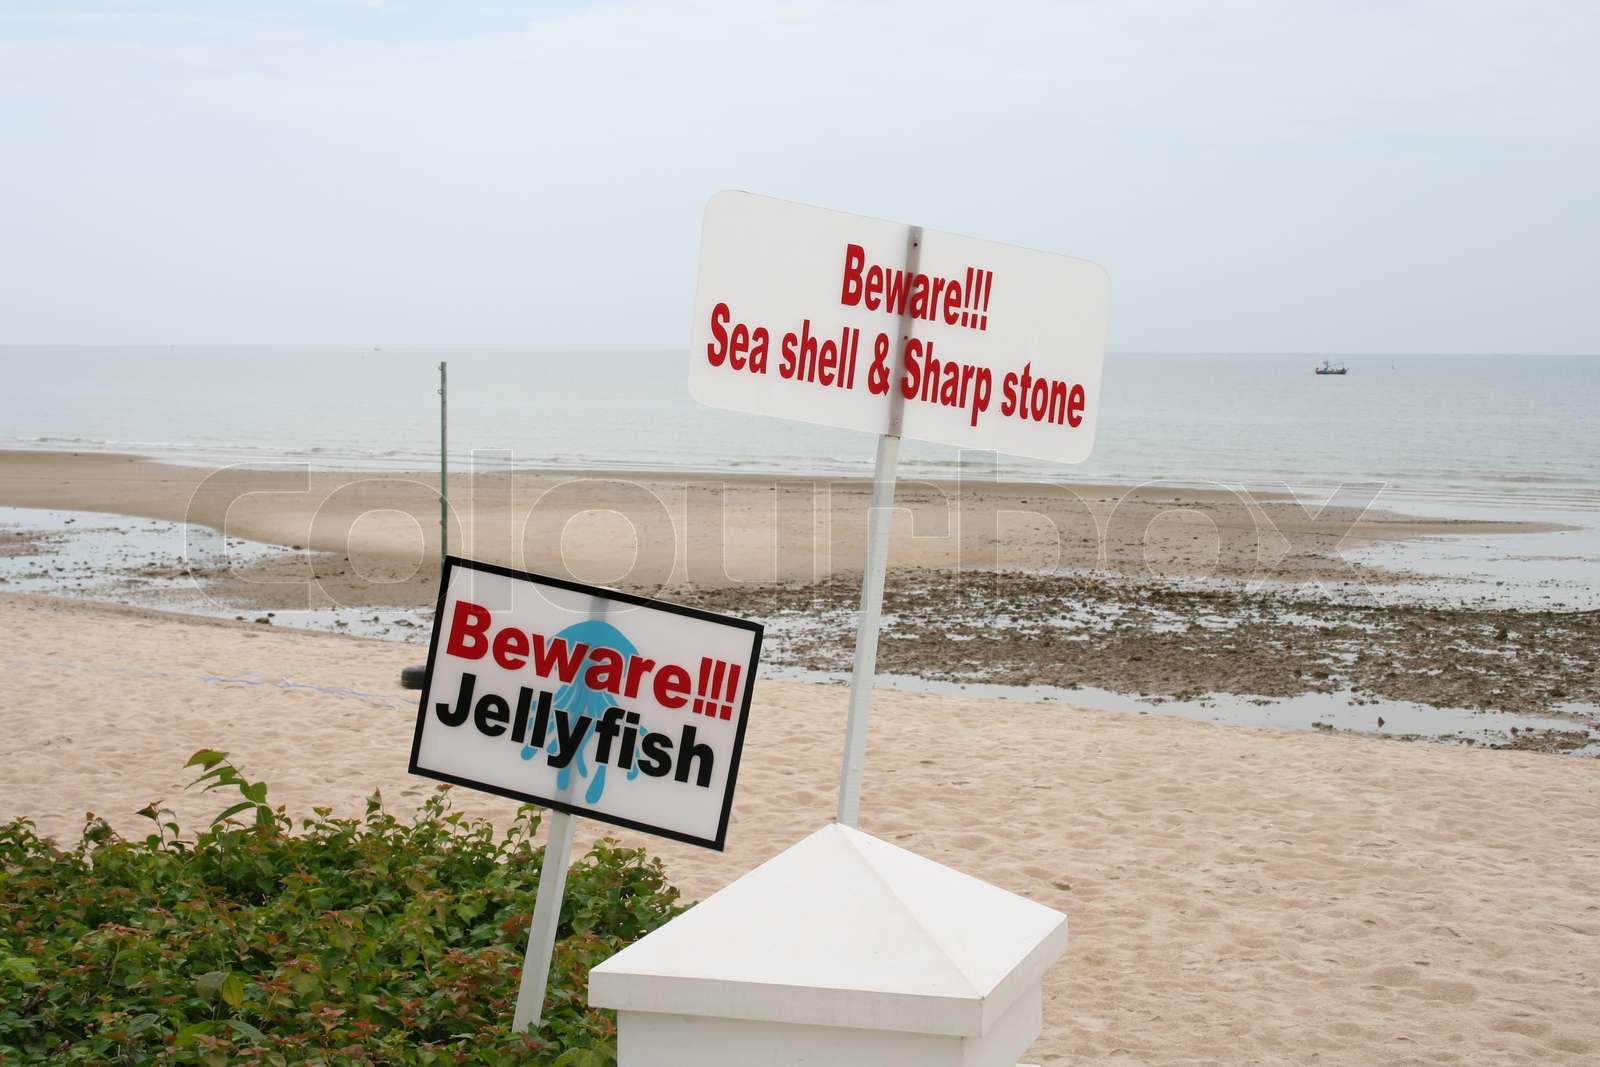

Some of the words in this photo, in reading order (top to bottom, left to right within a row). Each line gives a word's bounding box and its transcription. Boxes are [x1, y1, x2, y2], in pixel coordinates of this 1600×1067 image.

[841, 243, 993, 331] Beware!!!
[706, 303, 769, 374] Sea
[779, 319, 860, 390] shell
[867, 333, 890, 396] &
[901, 338, 992, 427] Sharp
[1001, 361, 1085, 428] stone
[446, 600, 742, 721] Beware!!!
[435, 672, 715, 788] Jellyfish
